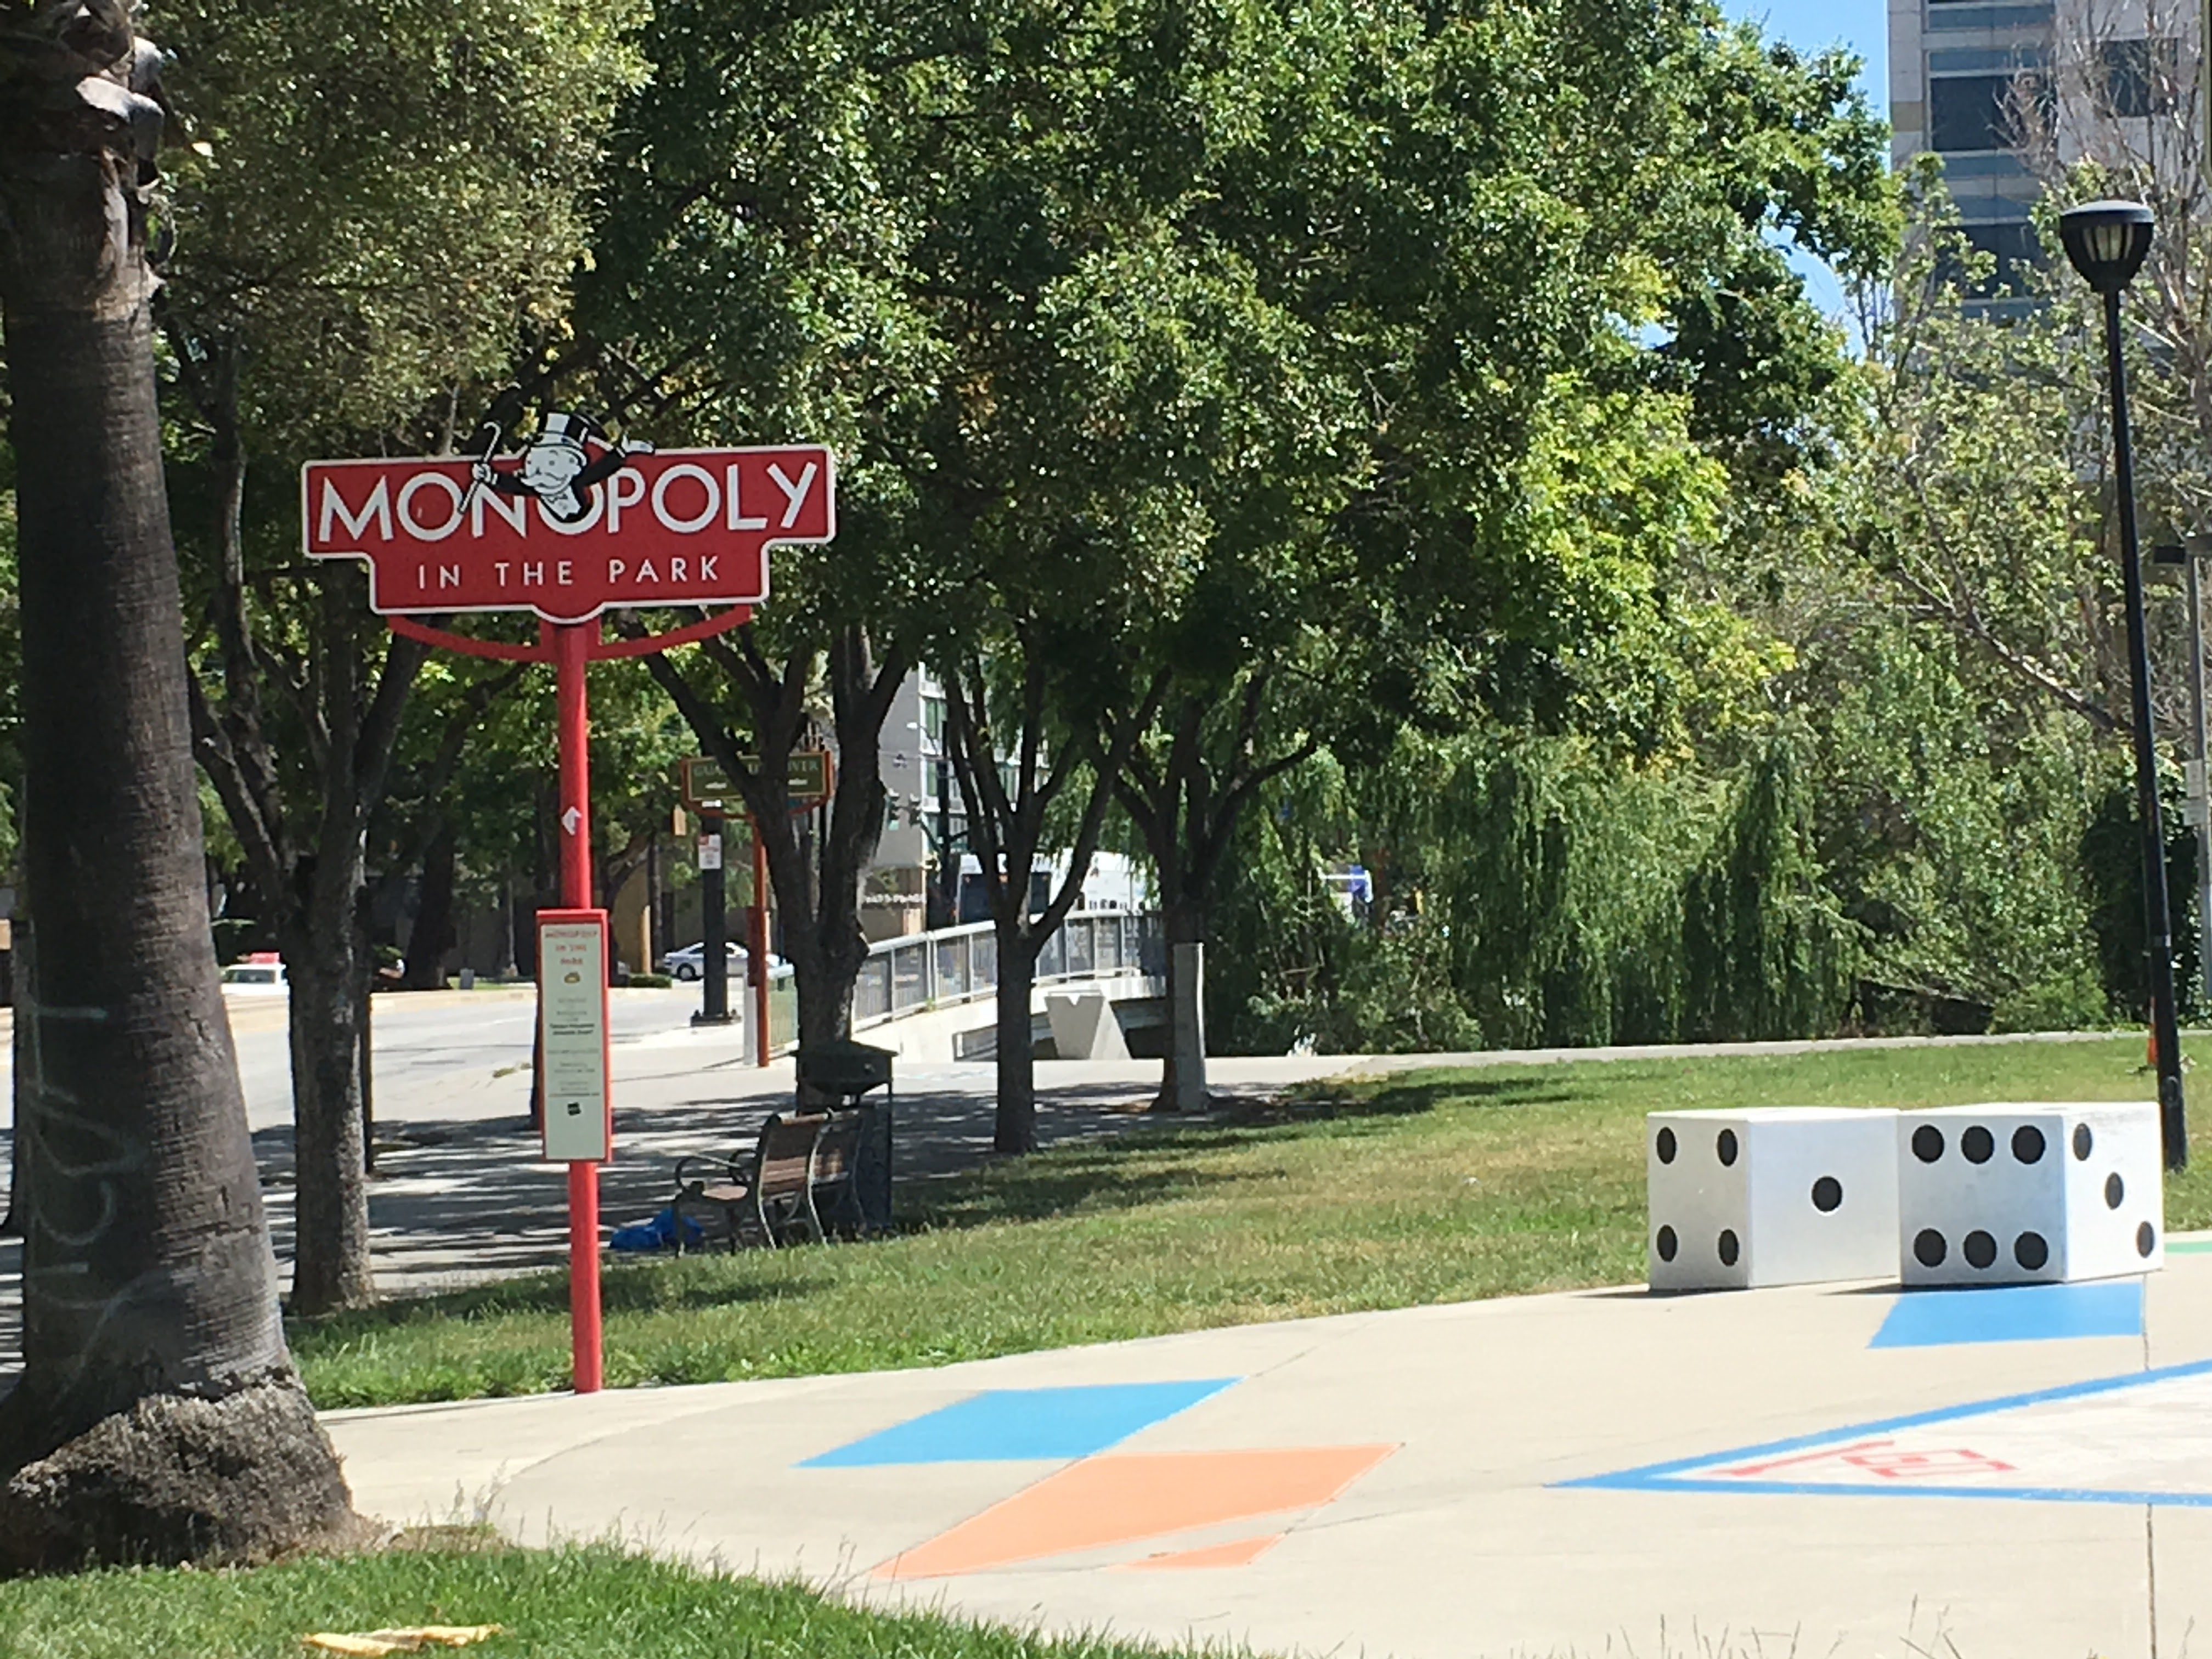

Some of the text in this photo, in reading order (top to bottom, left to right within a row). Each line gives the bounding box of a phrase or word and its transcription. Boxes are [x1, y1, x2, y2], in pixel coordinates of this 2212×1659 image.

[319, 462, 817, 542] MONOPOLY
[419, 556, 719, 589] IN THE PARK
